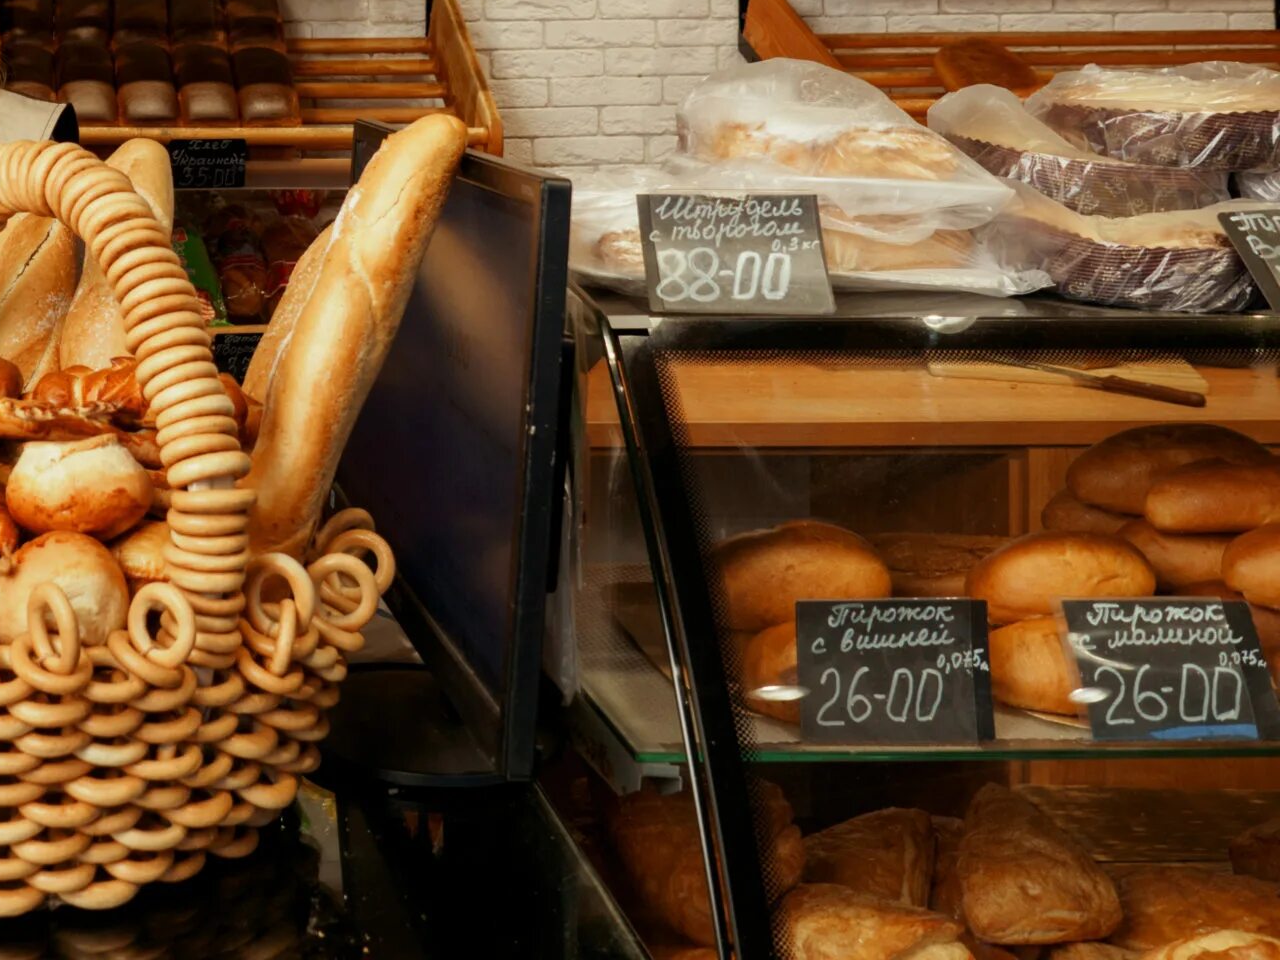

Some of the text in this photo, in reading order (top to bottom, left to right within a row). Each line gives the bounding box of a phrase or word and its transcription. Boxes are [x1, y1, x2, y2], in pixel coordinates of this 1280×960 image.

[656, 196, 804, 228] Штрудель
[648, 219, 805, 248] с творогом
[656, 246, 791, 303] 88-00
[827, 602, 955, 632] Пирожок
[1086, 602, 1230, 631] Пирожок
[811, 624, 956, 654] с вишней
[1078, 624, 1246, 651] с малиной
[816, 666, 944, 728] 26-00
[1093, 663, 1243, 726] 26-00
